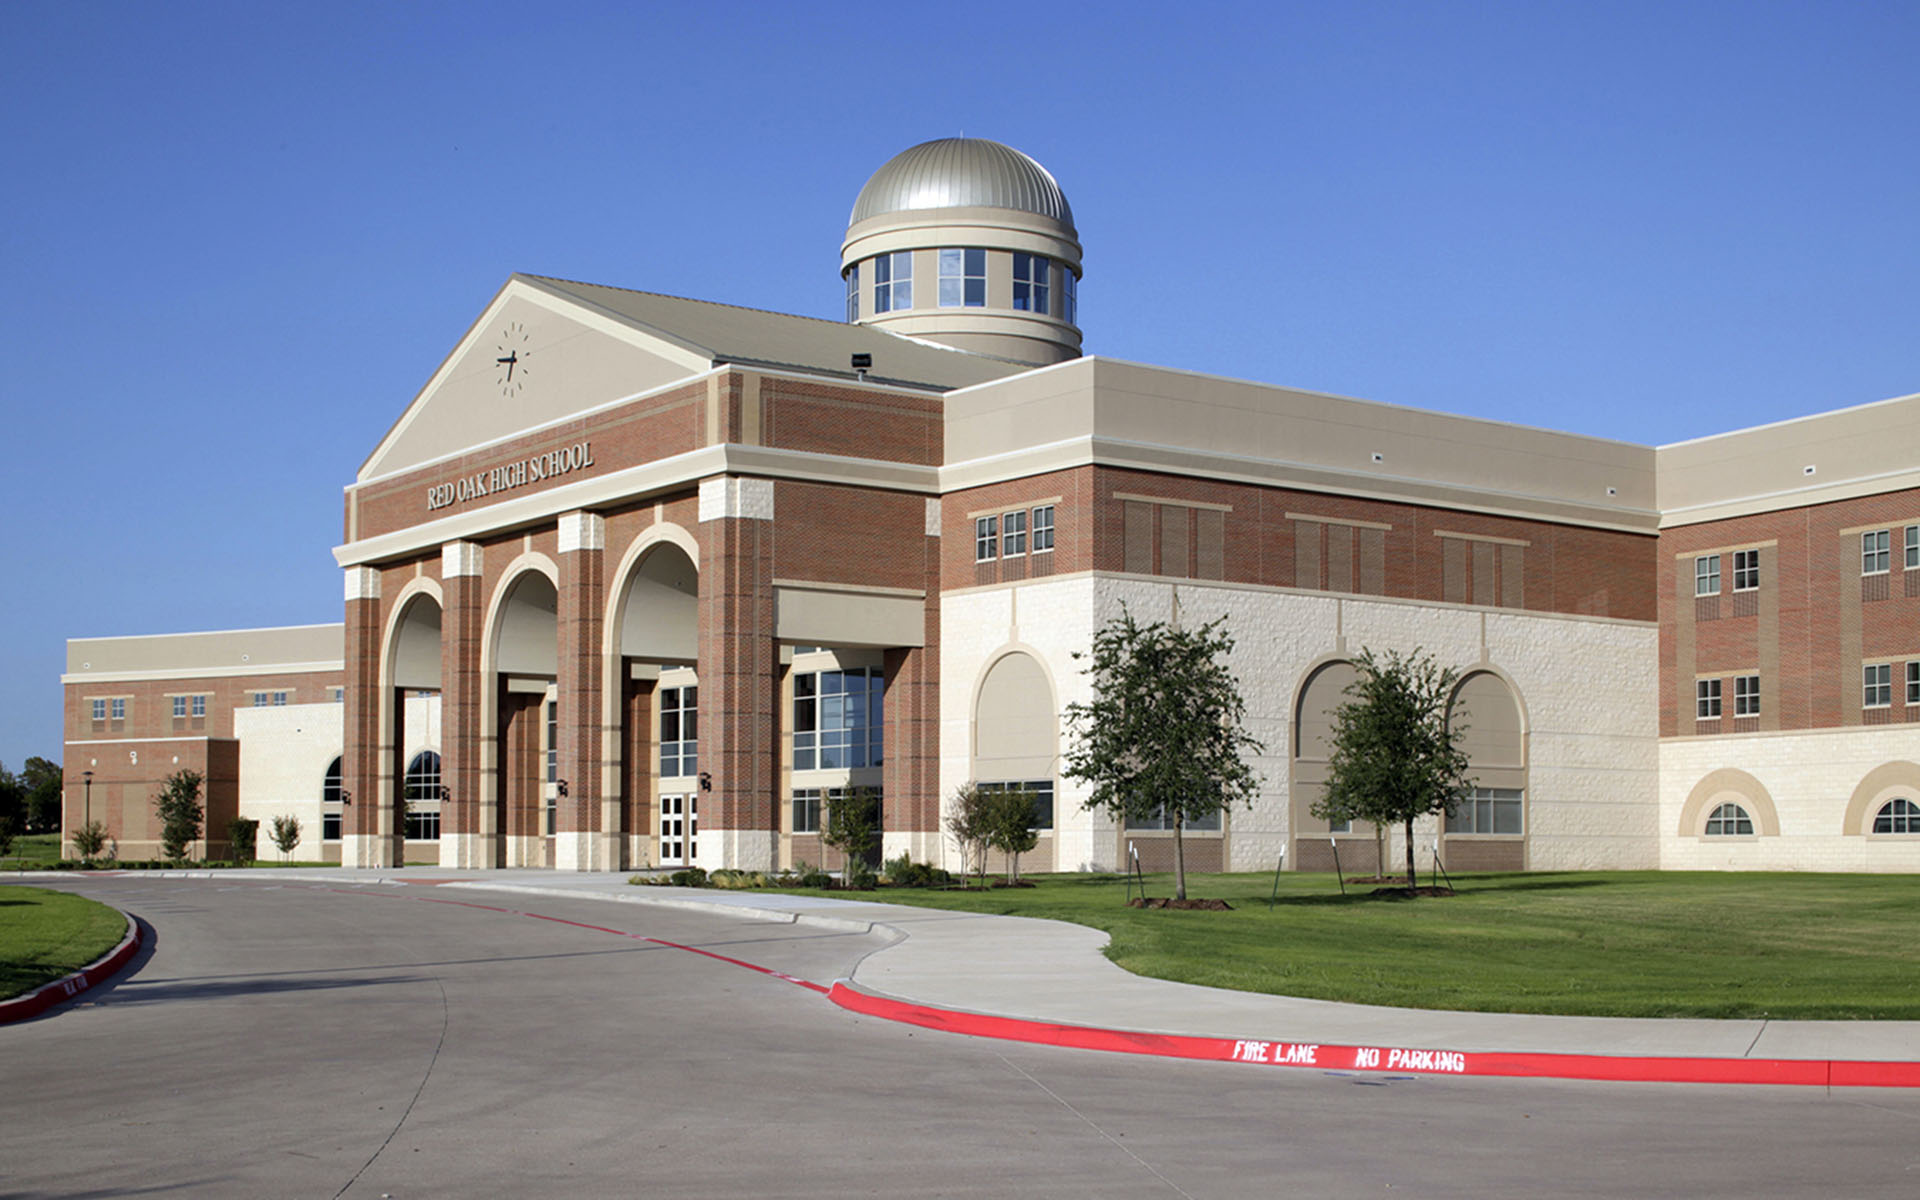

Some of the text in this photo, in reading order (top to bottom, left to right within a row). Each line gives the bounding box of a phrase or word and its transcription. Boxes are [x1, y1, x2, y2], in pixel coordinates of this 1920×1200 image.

[427, 442, 594, 511] RED OAK HIGH SCHOOL
[1232, 1040, 1465, 1072] FIRE LANE NO PARKING
